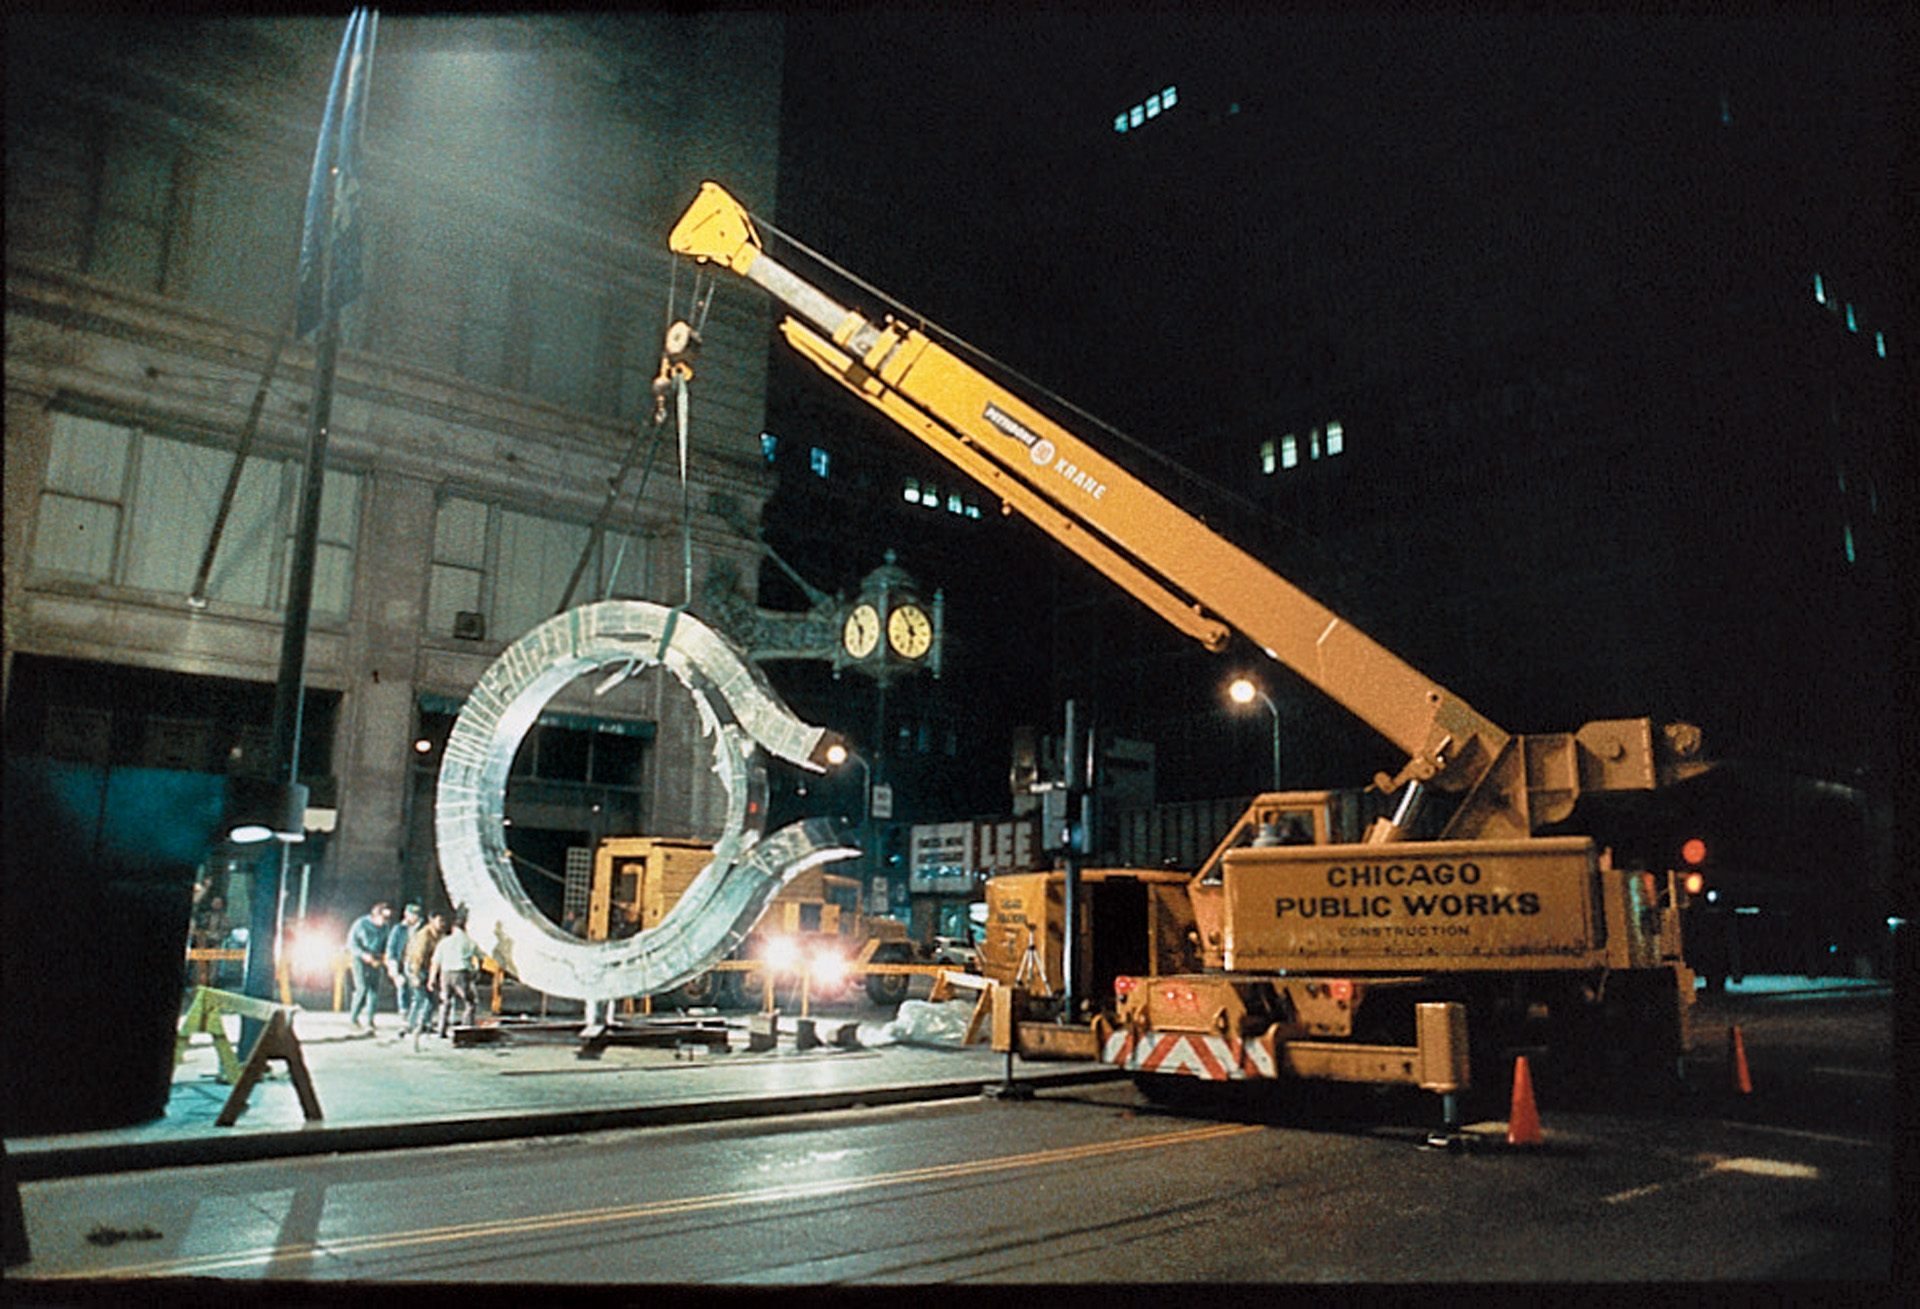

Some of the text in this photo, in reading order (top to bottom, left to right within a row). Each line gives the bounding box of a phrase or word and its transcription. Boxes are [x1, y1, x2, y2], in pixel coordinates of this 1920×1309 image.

[1054, 457, 1107, 499] KRANE
[980, 822, 1032, 868] LEE
[1327, 862, 1481, 888] CHICAGO
[1276, 892, 1540, 919] PUBLIC WORKS
[1338, 924, 1470, 938] CONSTRUCTION
